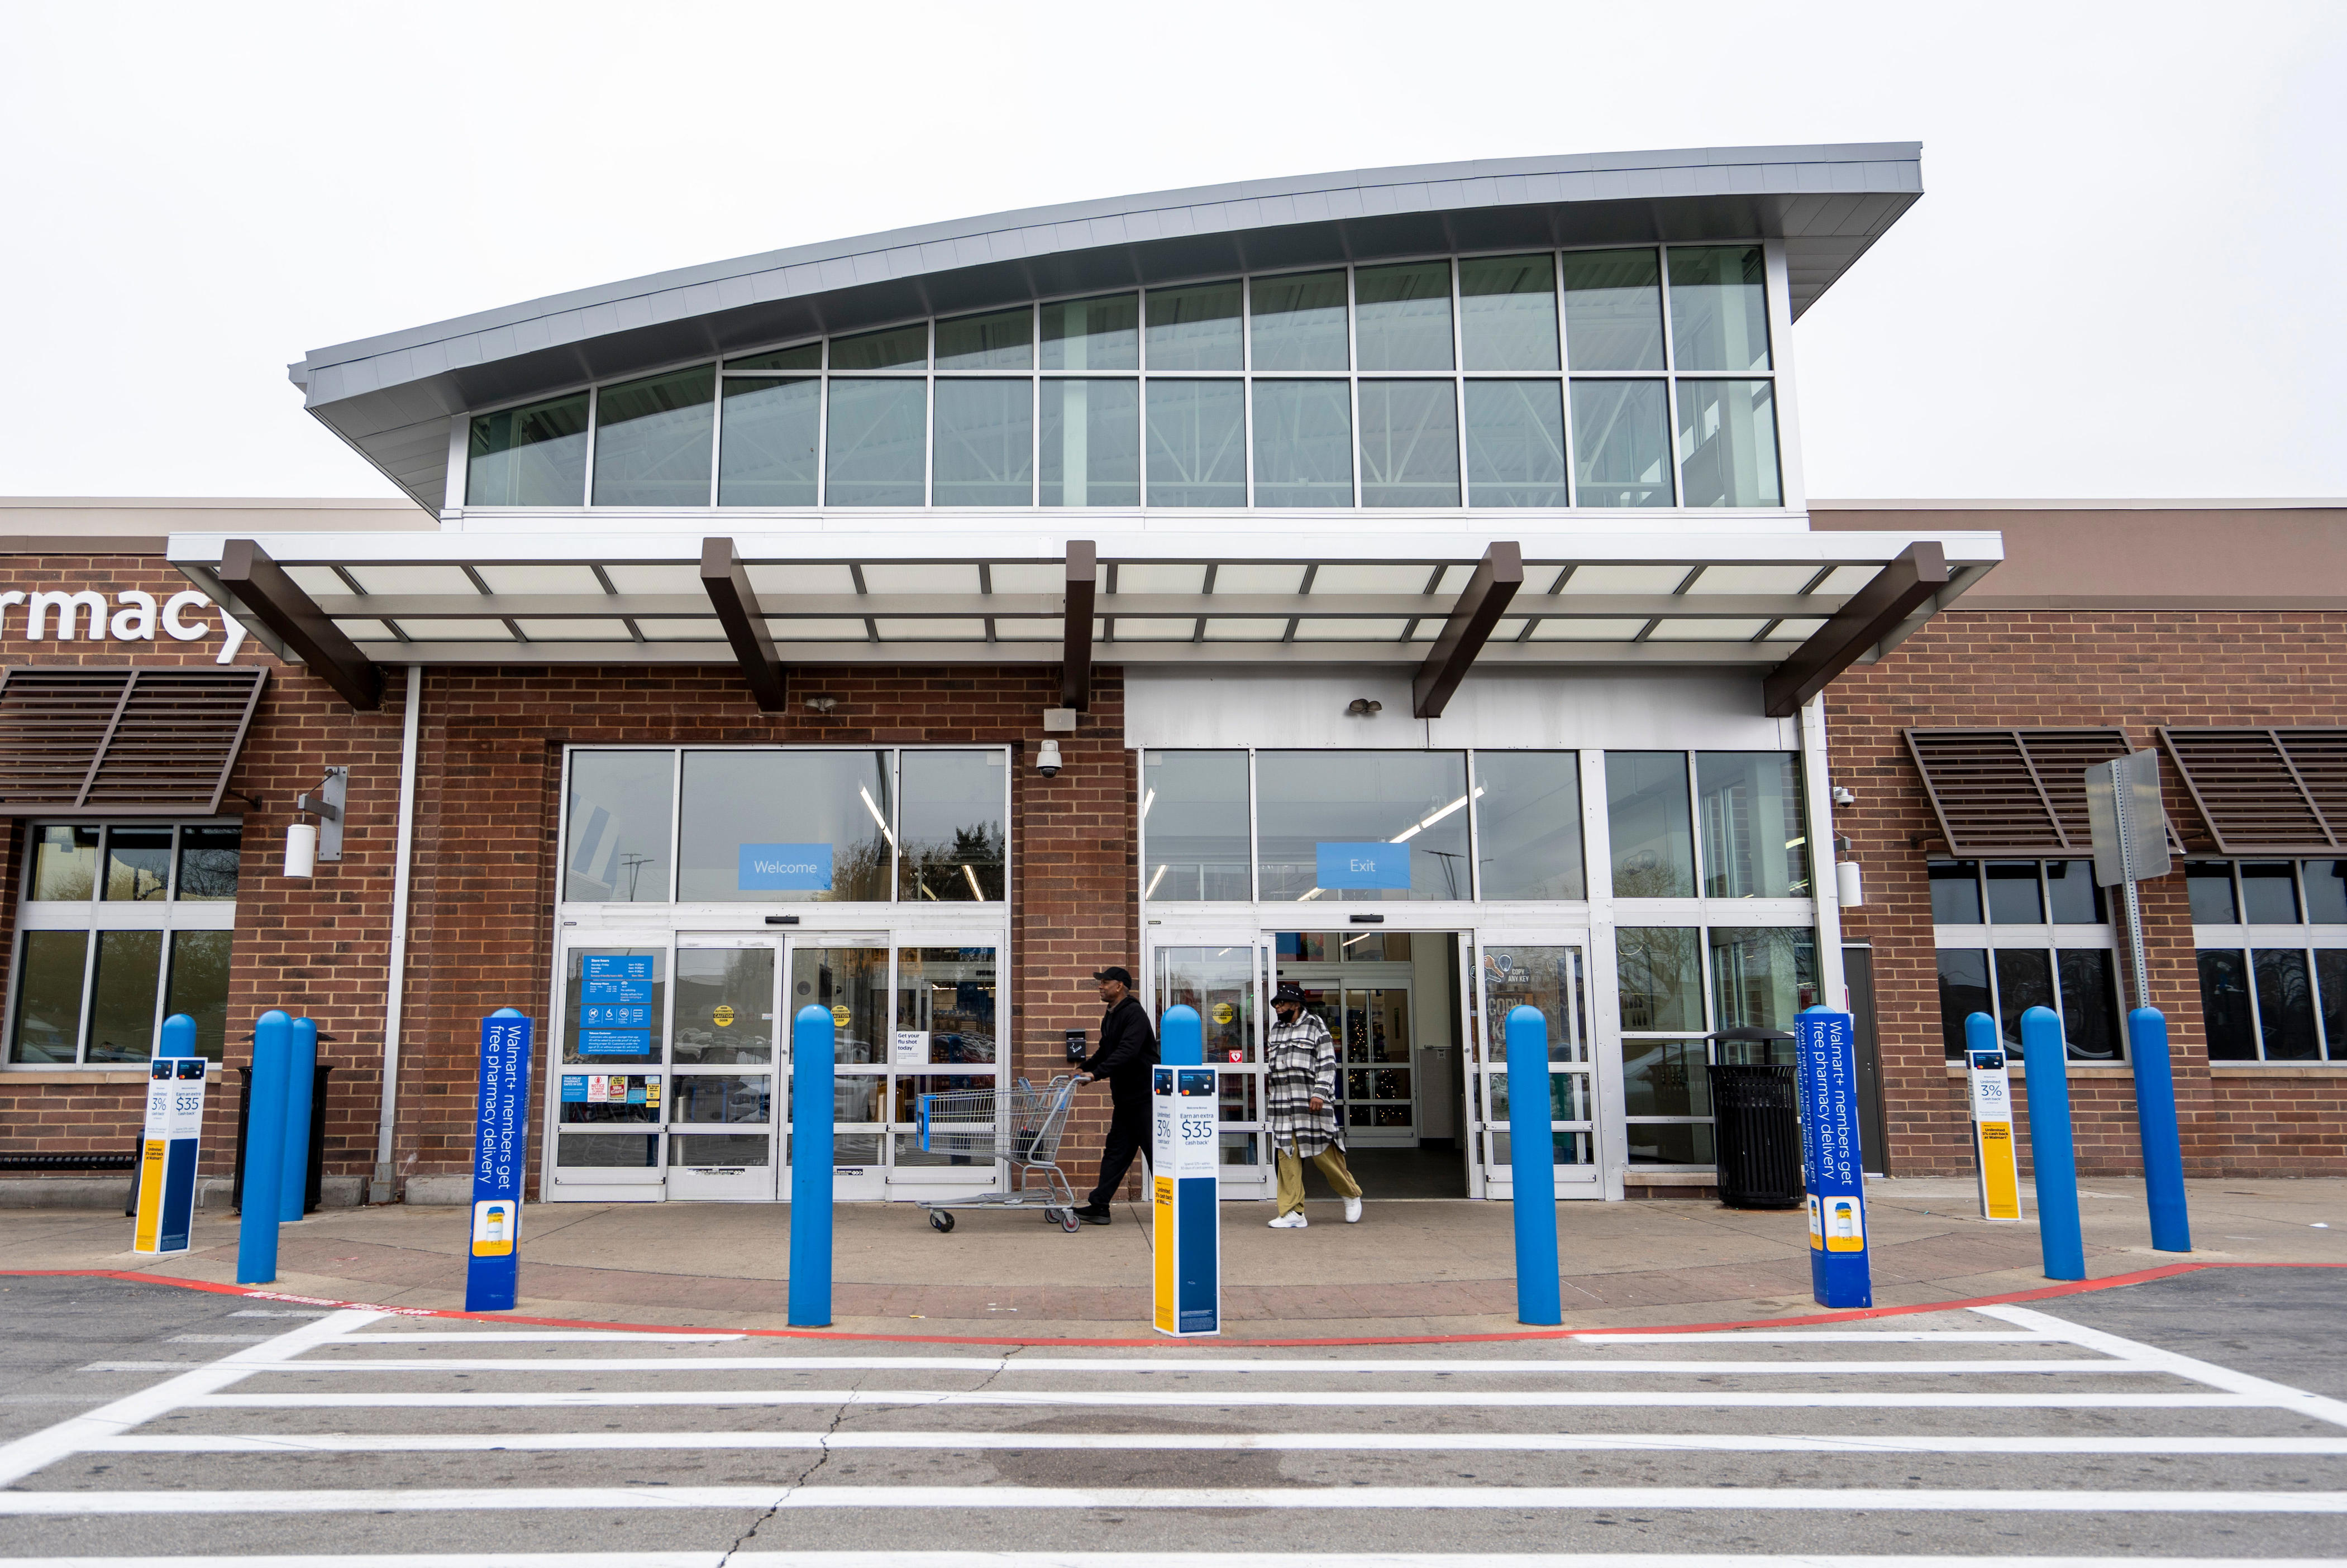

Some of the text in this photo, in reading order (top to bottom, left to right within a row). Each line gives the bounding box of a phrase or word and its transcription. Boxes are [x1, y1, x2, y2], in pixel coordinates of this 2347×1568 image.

[754, 861, 817, 873] Welcome
[1351, 859, 1376, 872] Exit
[1796, 1052, 1805, 1120] pharmacy
[1800, 1022, 1808, 1086] Walmart+
[1805, 1090, 1814, 1157] members
[1981, 1085, 2002, 1096] 3%
[152, 1098, 167, 1110] 3%
[176, 1097, 199, 1112] $35
[478, 1025, 504, 1183] free pharmacy delivery
[497, 1026, 521, 1189] Walmart+ members get
[1812, 1021, 1835, 1179] free pharmacy delivery
[1830, 1021, 1853, 1185] Walmart+ members get
[1157, 1120, 1170, 1137] 3%
[1182, 1119, 1211, 1140] $35
